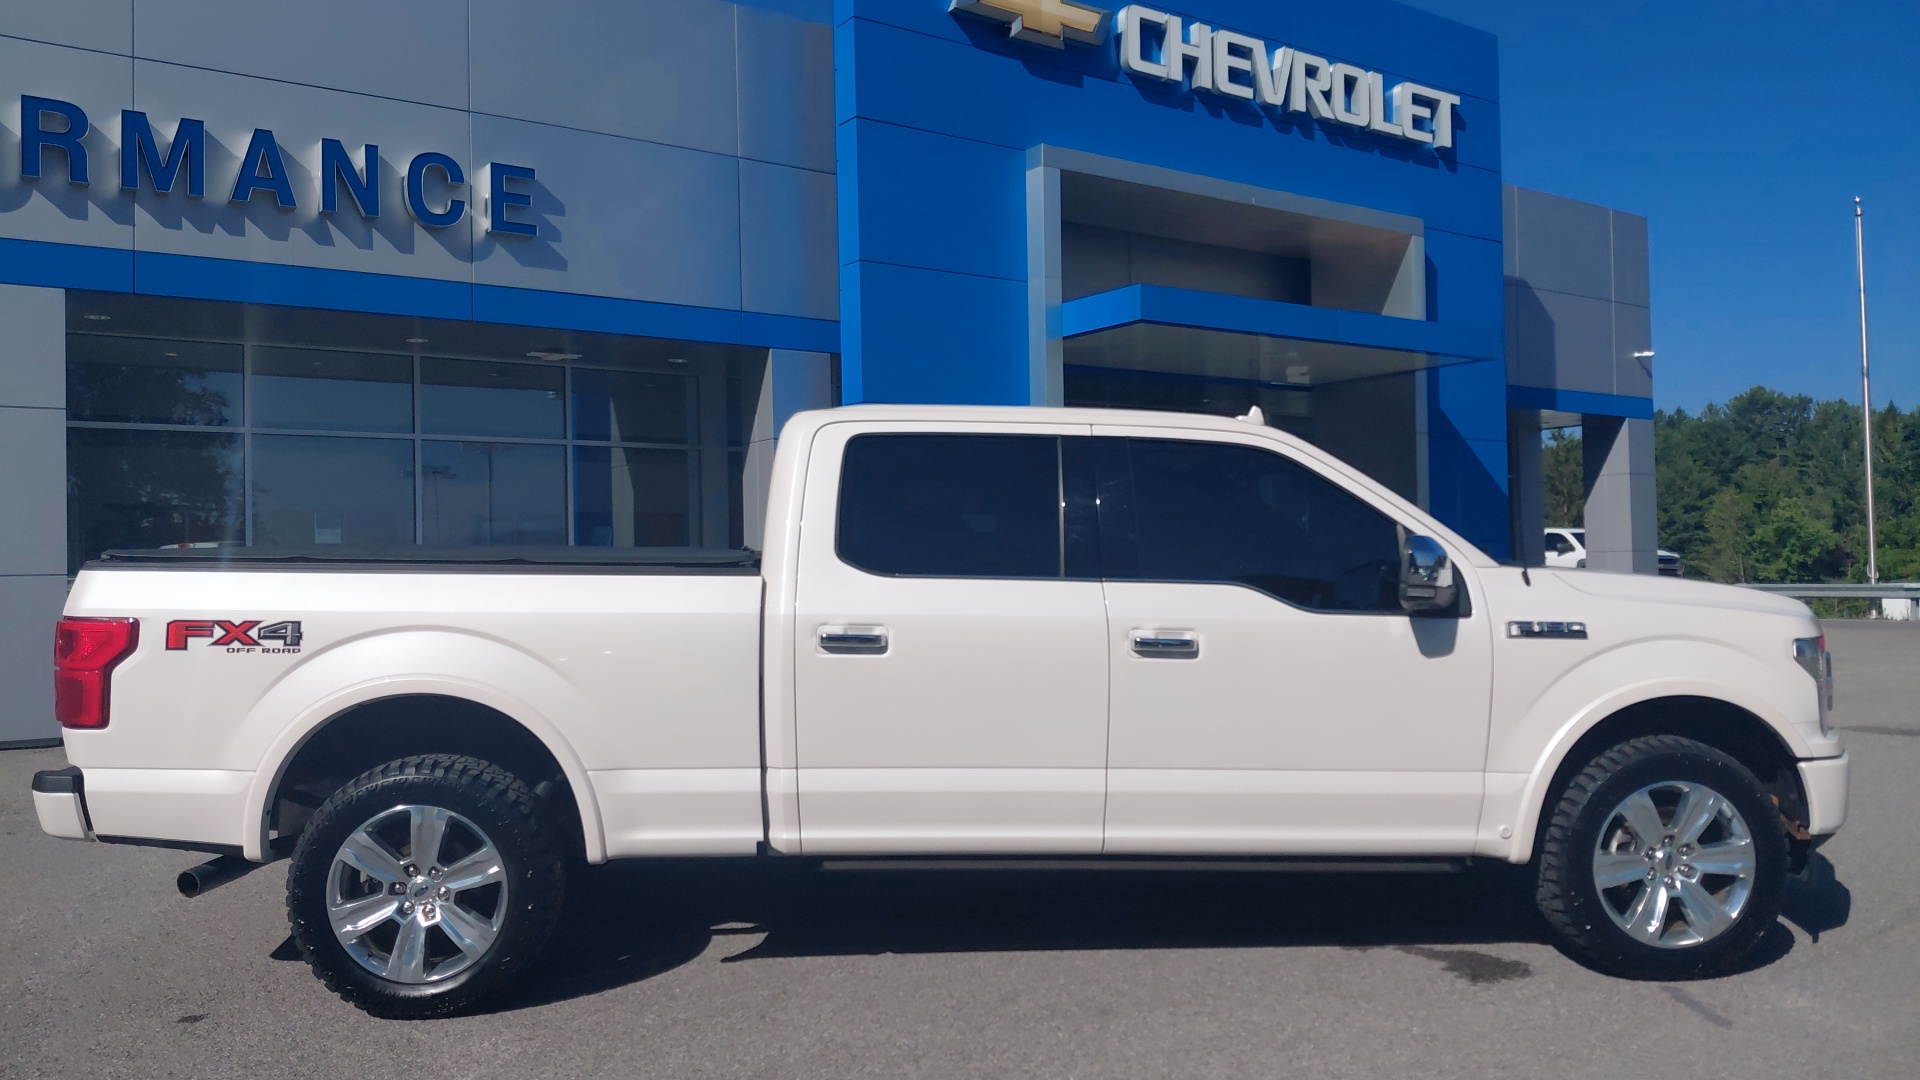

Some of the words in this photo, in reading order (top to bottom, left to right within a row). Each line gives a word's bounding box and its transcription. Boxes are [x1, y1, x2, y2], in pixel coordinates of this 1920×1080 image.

[1118, 4, 1461, 149] CHEVROLET
[20, 94, 539, 237] RMANCE
[165, 620, 302, 651] FX4
